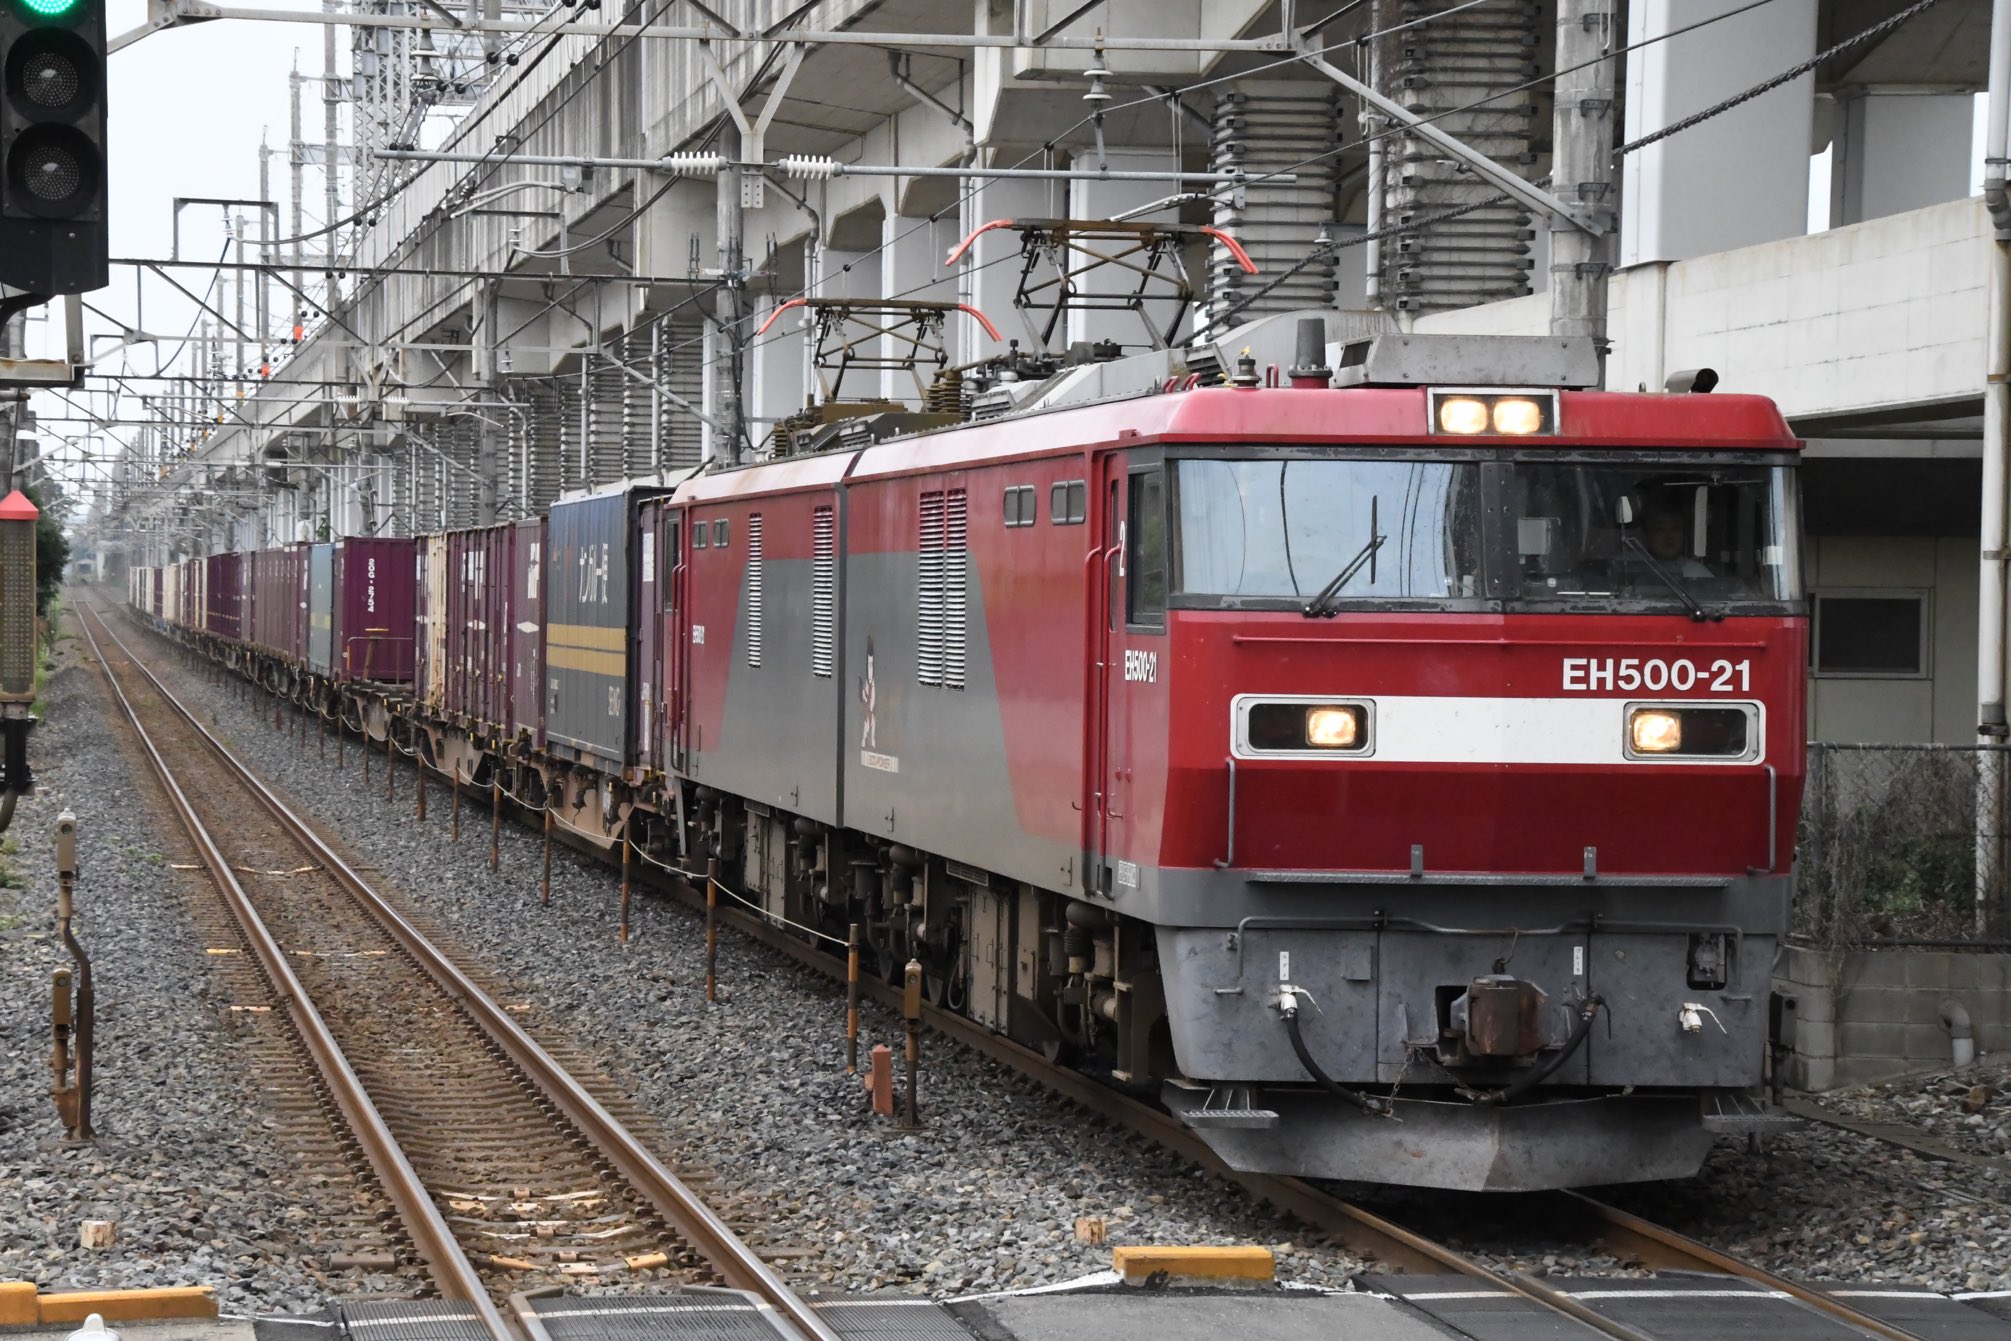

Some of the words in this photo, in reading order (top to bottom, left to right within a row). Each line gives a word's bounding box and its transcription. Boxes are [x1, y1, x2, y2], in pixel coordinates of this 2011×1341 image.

[1119, 520, 1126, 577] 2
[1124, 649, 1157, 683] EH500-21
[1562, 657, 1750, 692] EH500-21
